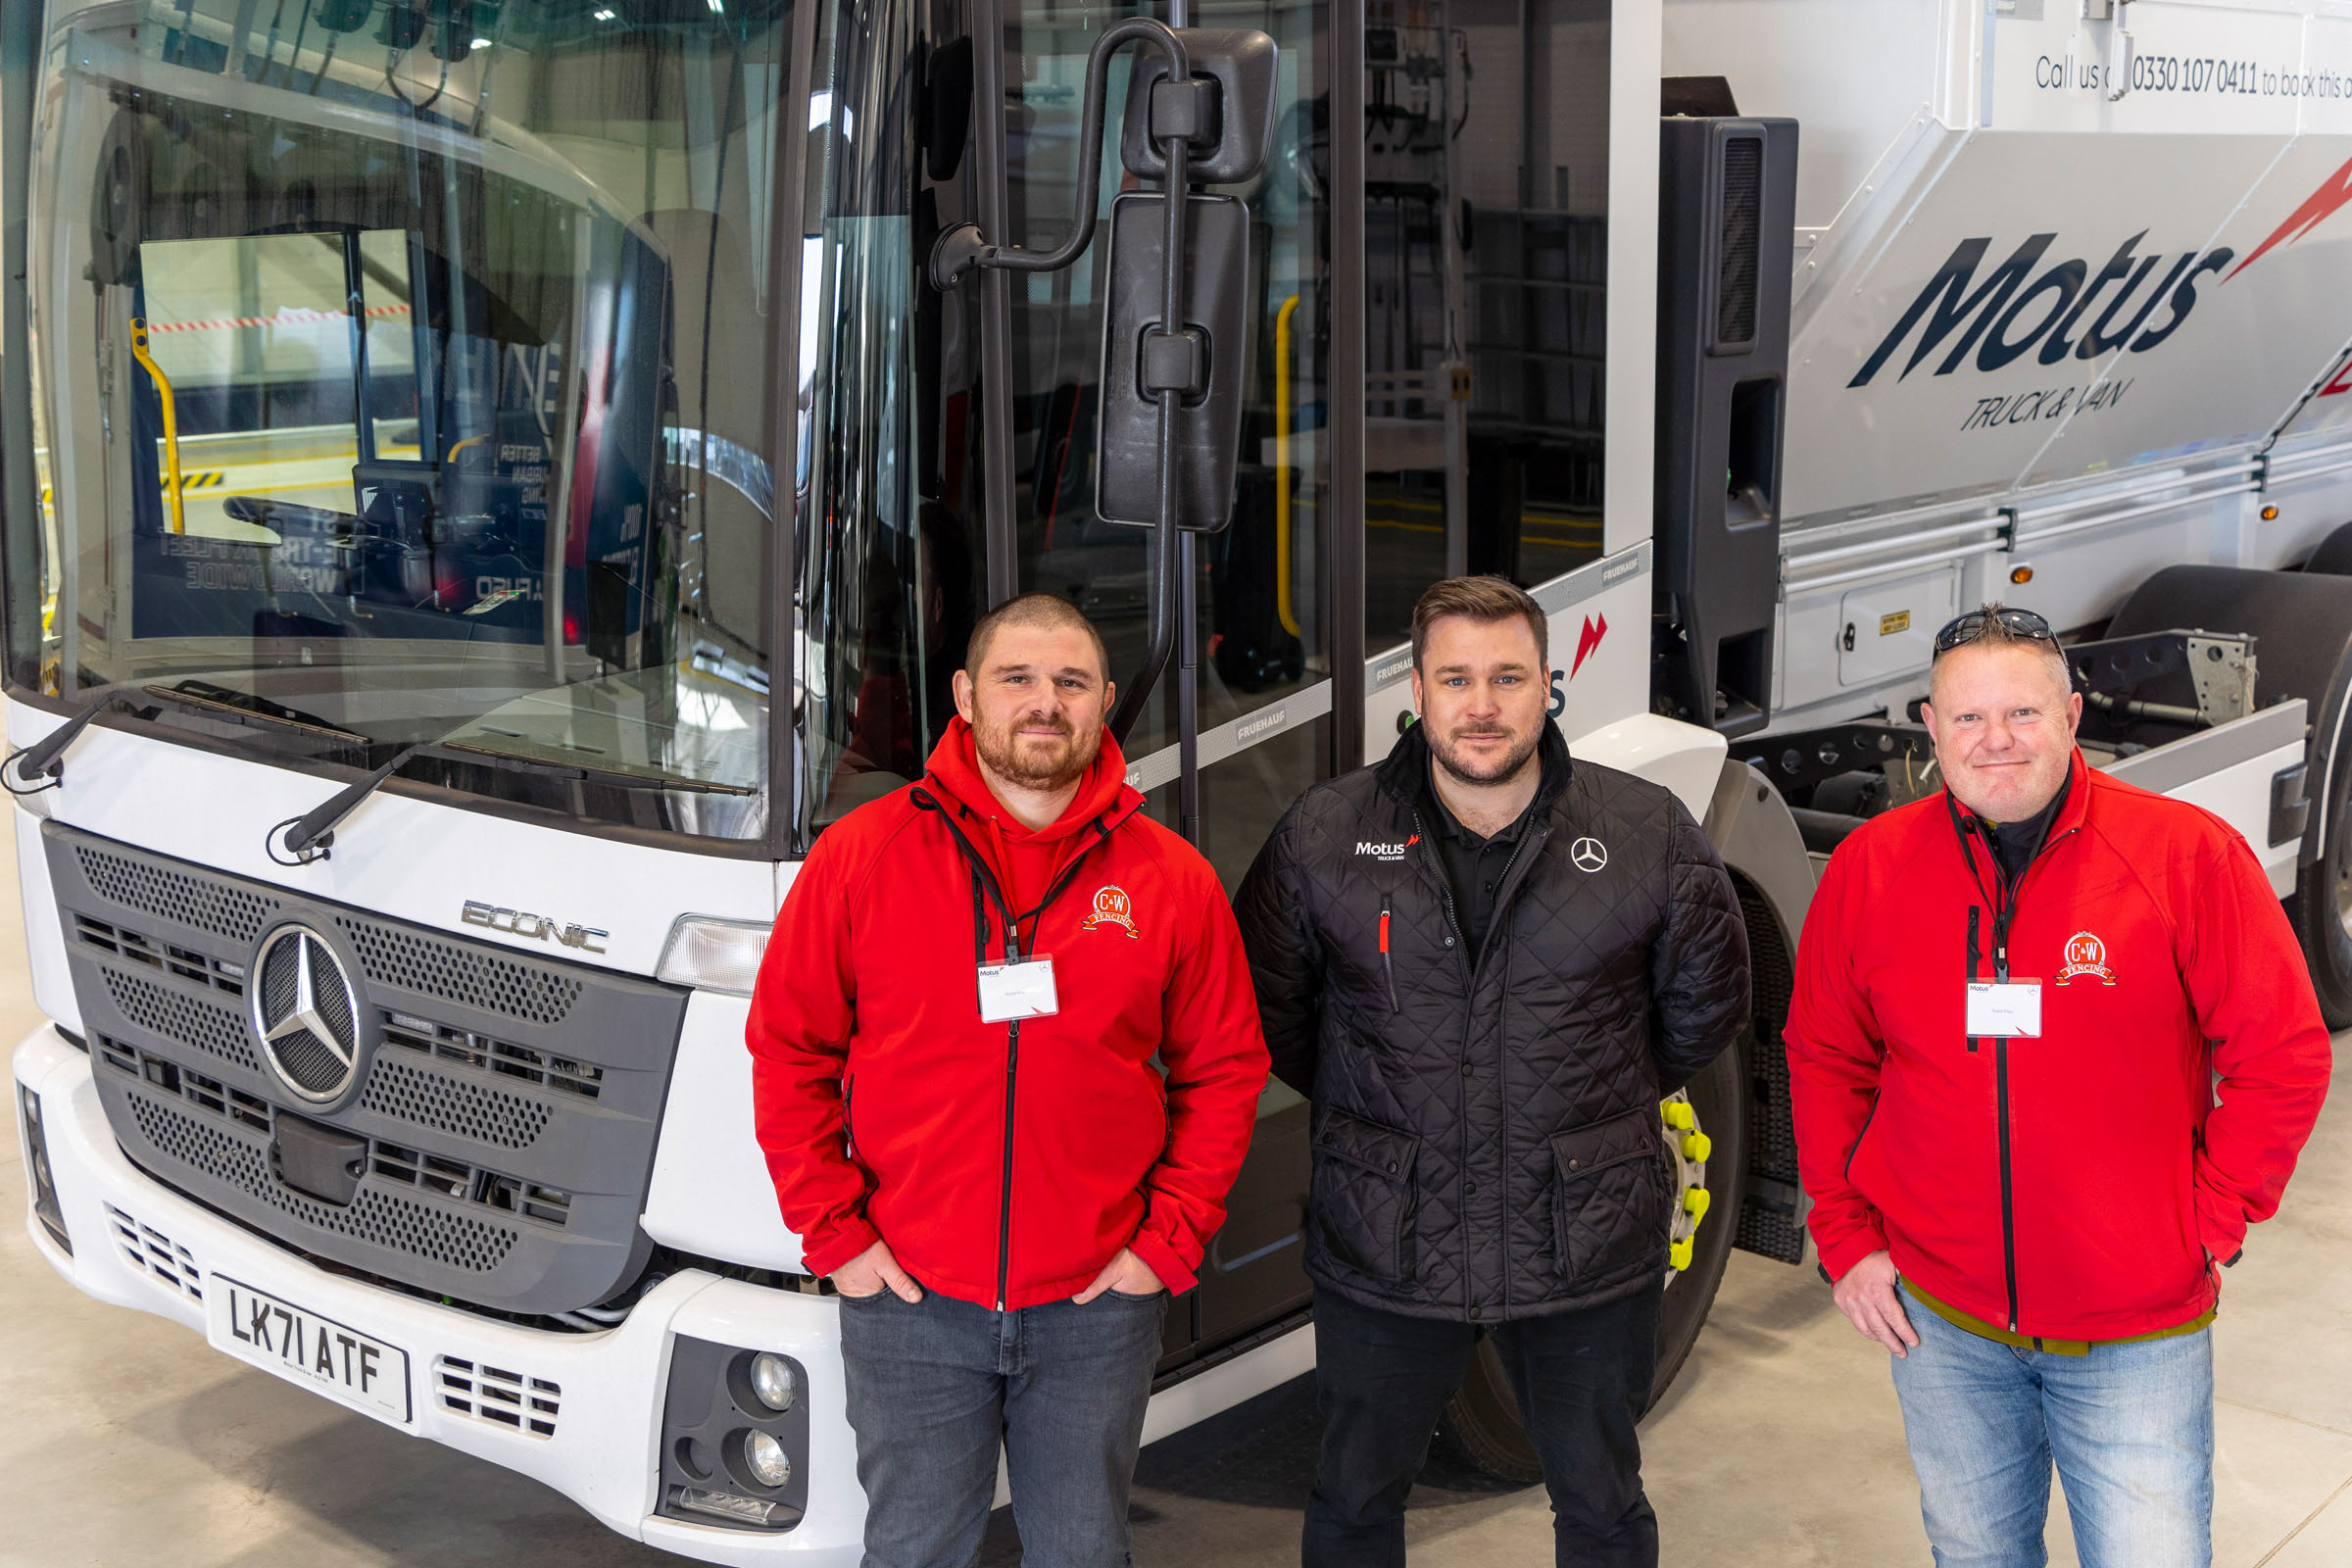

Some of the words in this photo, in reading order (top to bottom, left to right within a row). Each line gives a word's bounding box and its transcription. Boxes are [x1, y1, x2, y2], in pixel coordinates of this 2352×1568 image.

[2035, 54, 2074, 89] Call
[2079, 65, 2100, 89] us
[2132, 55, 2179, 92] 0330
[2181, 58, 2215, 93] 107
[2217, 60, 2258, 94] 0411
[2262, 69, 2278, 96] to
[2280, 64, 2316, 97] book
[2319, 67, 2341, 98] this
[1845, 227, 2235, 389] Motus
[1960, 388, 2057, 431] TRUCK
[2045, 386, 2076, 419] &
[2074, 377, 2134, 416] VAN
[1603, 558, 1639, 582] FRUEHAUF
[1376, 657, 1413, 682] FRUEHAU
[1238, 710, 1286, 741] FRUEHAUF
[1354, 842, 1405, 856] Motus
[462, 900, 610, 955] ECONIC
[1094, 912, 1130, 926] FENCING
[2066, 964, 2106, 976] FENCING
[230, 1289, 305, 1366] LK71
[316, 1326, 380, 1394] ATF
